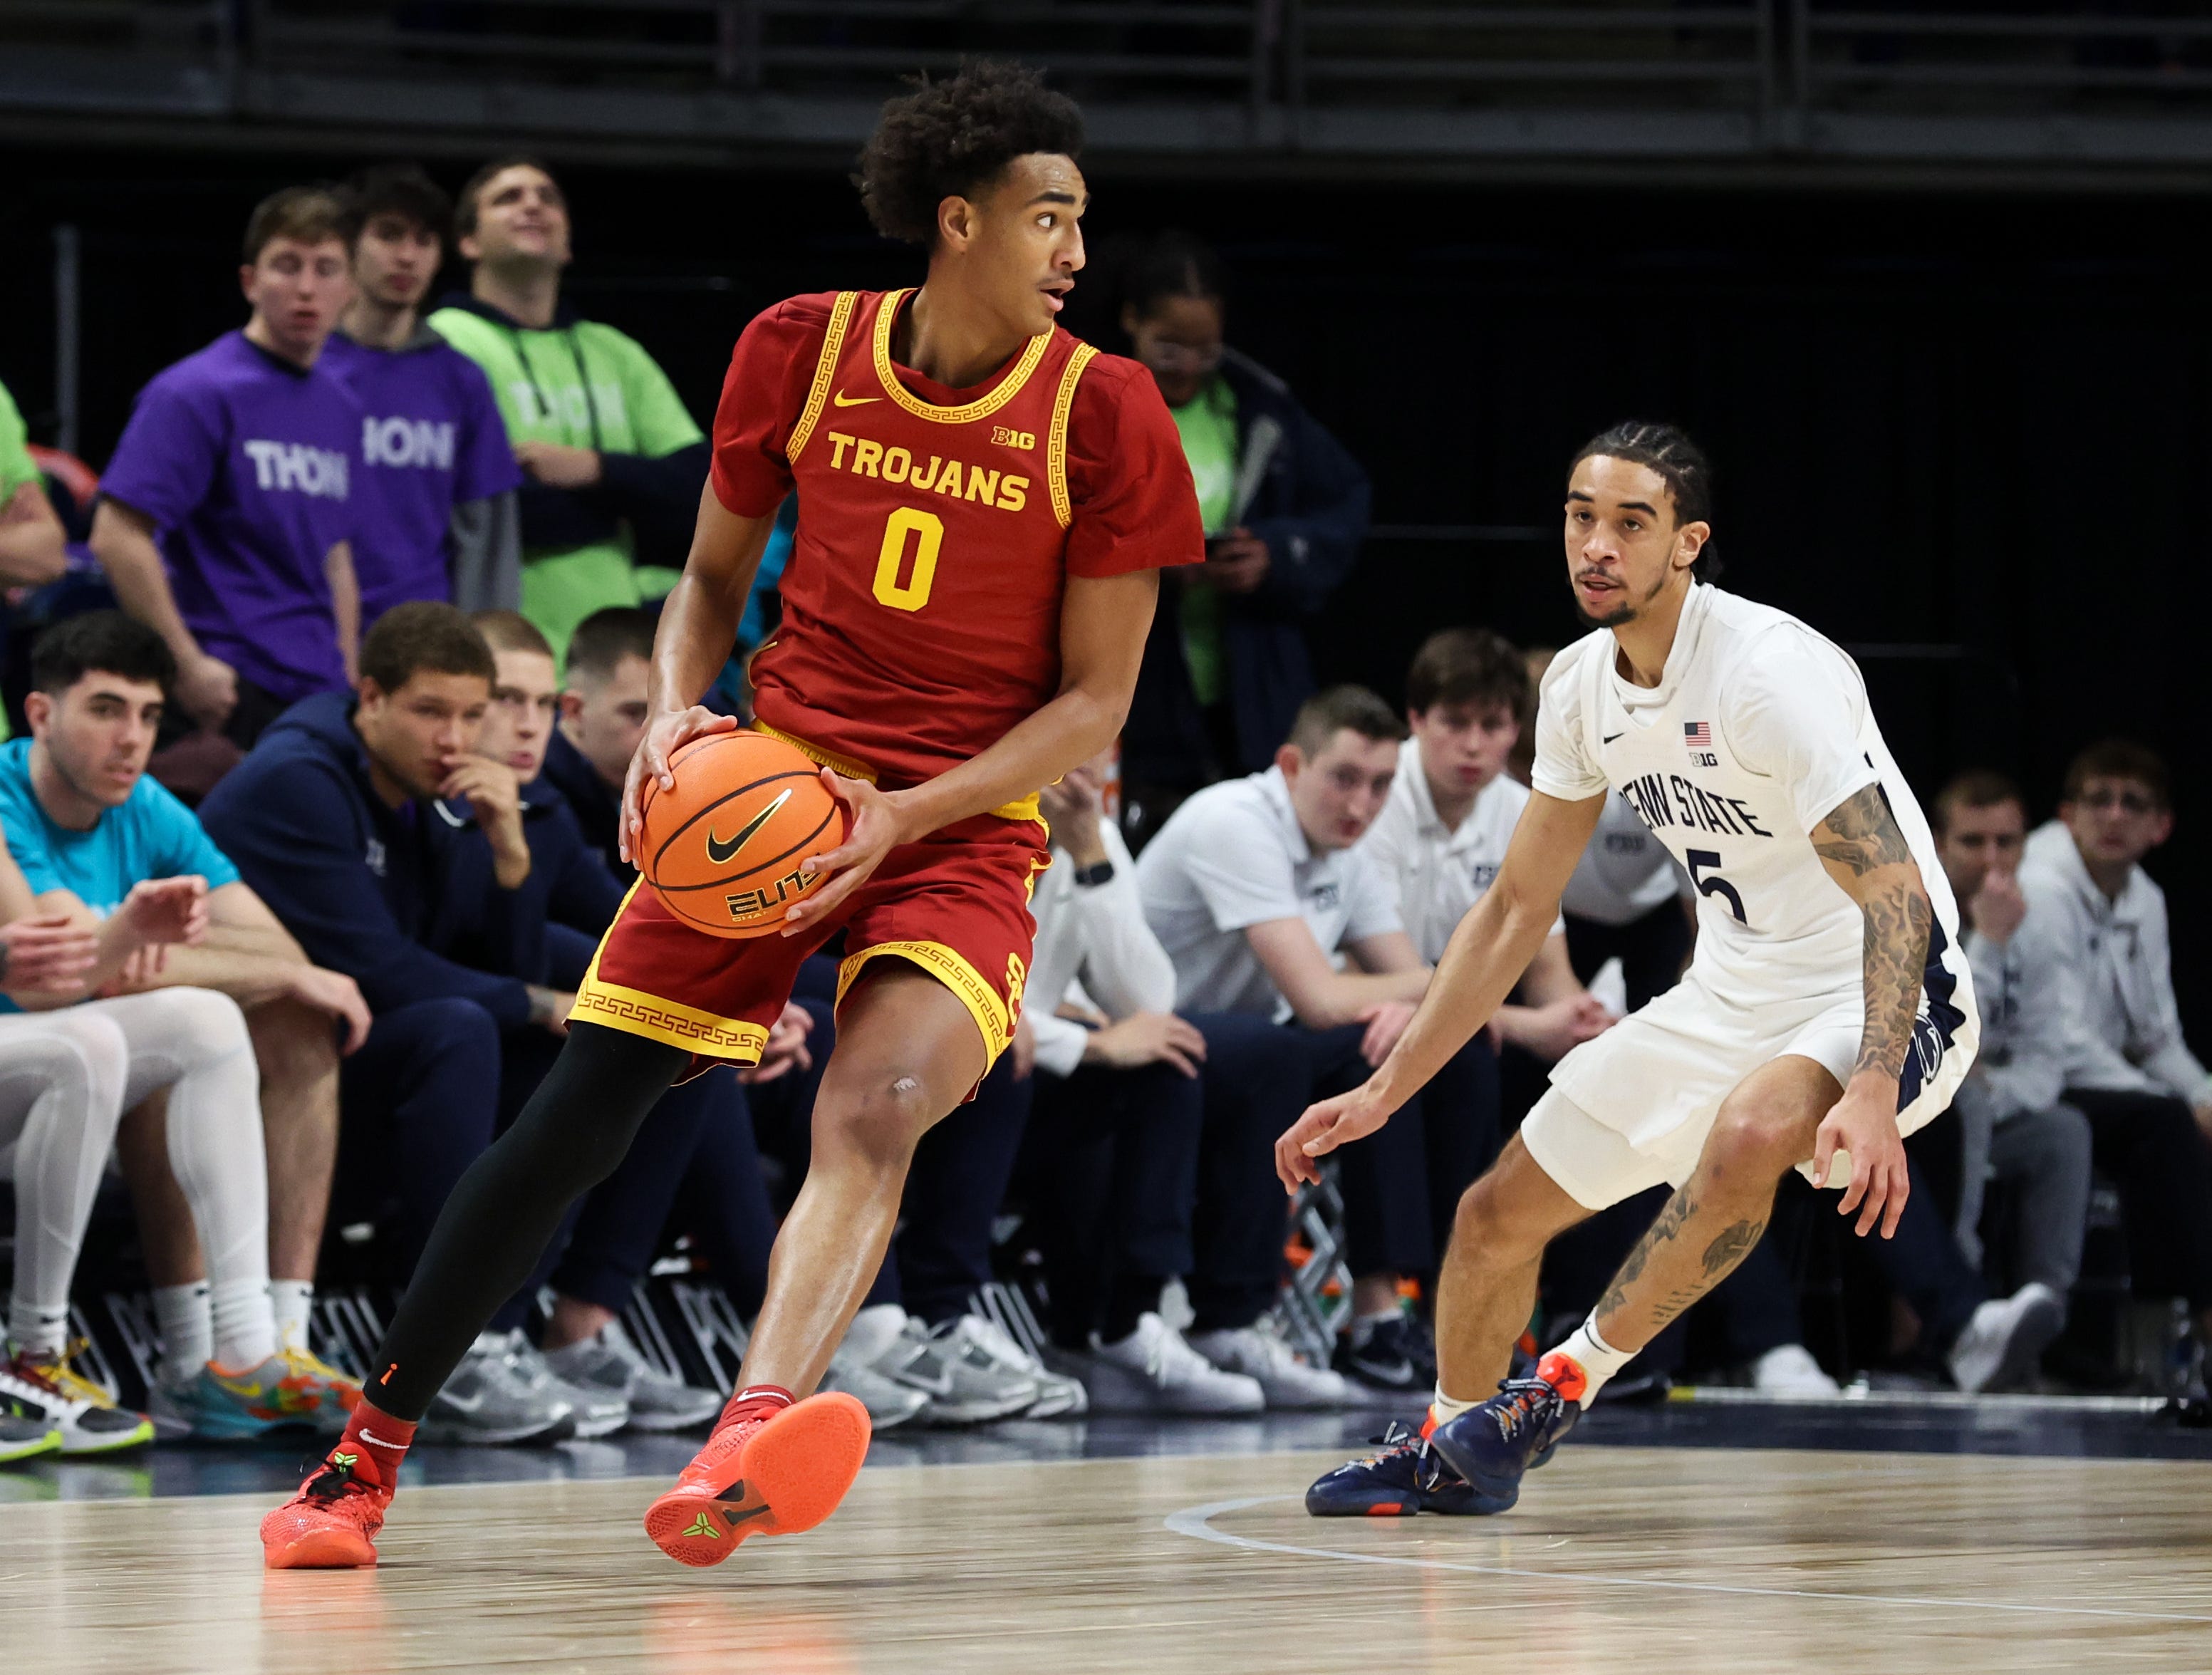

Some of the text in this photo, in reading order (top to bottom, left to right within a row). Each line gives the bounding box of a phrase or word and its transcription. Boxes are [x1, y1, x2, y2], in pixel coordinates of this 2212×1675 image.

[828, 431, 1030, 512] TROJANS
[872, 507, 945, 612] 0
[1619, 773, 1774, 838] ENN STATE
[1686, 848, 1748, 926] 5
